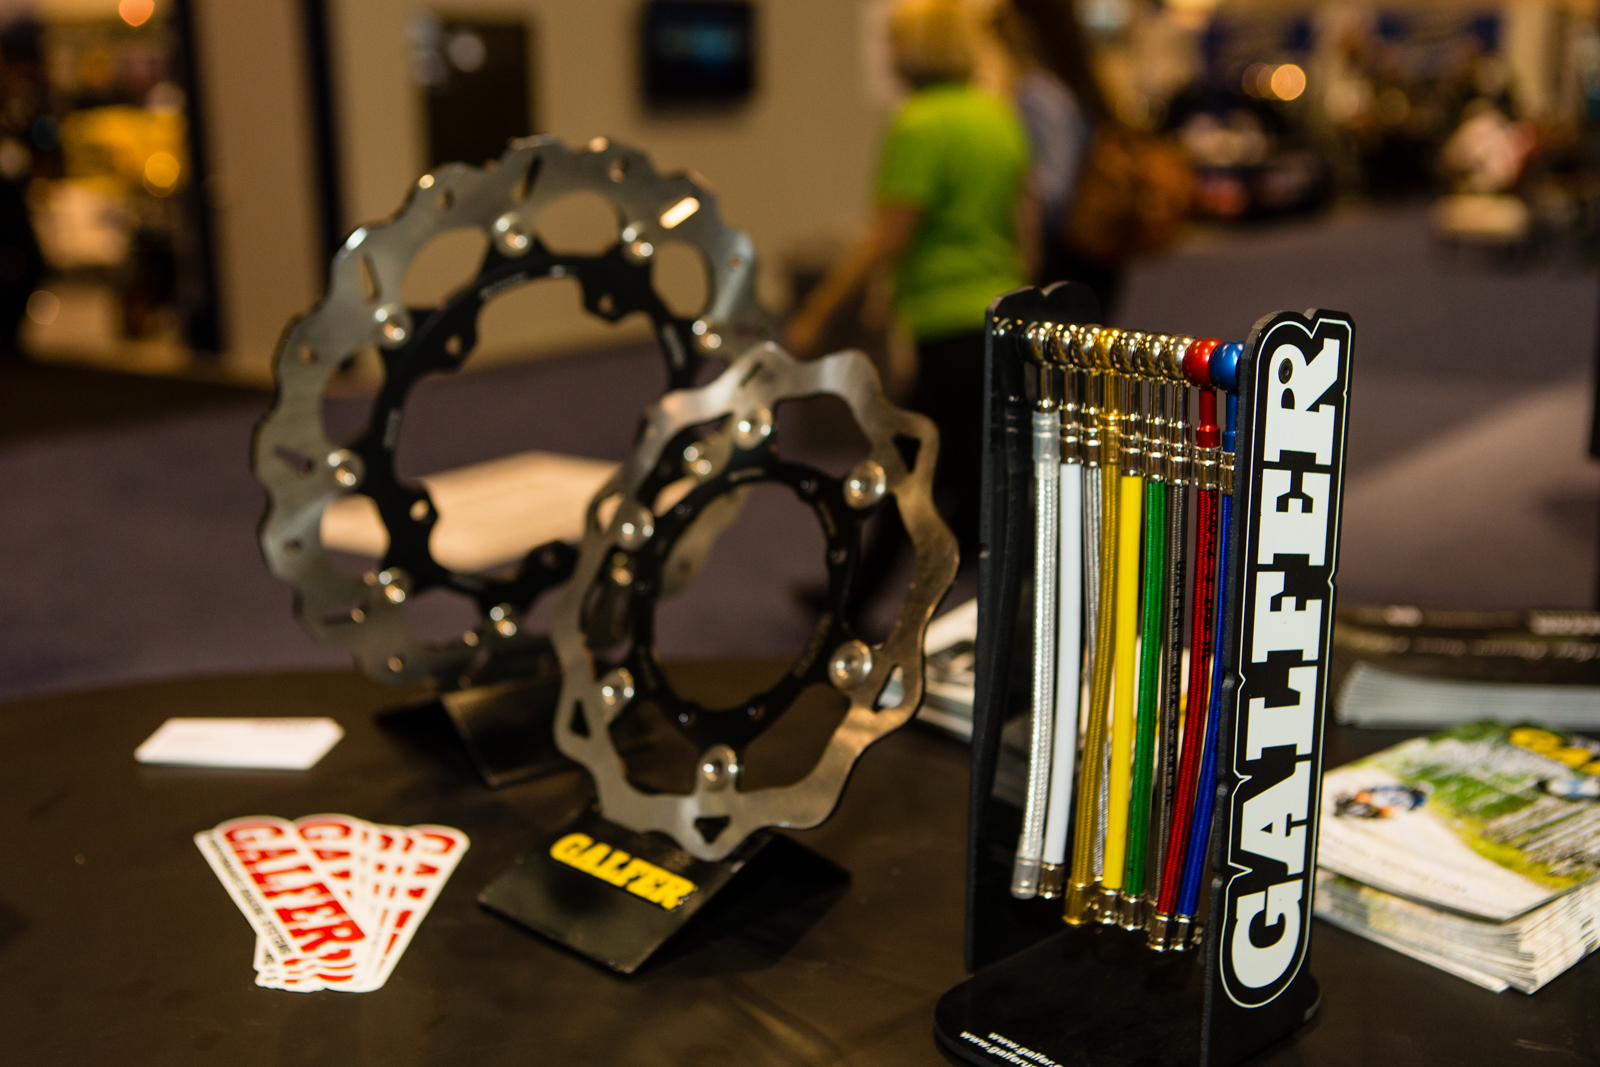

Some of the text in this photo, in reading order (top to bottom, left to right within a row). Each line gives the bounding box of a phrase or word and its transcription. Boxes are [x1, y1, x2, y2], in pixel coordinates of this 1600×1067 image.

[1173, 560, 1186, 629] GALFER
[1231, 337, 1341, 989] GALFER
[223, 822, 366, 953] GALFER
[549, 832, 697, 910] GALFER
[959, 1030, 1038, 1067] www.galferu
